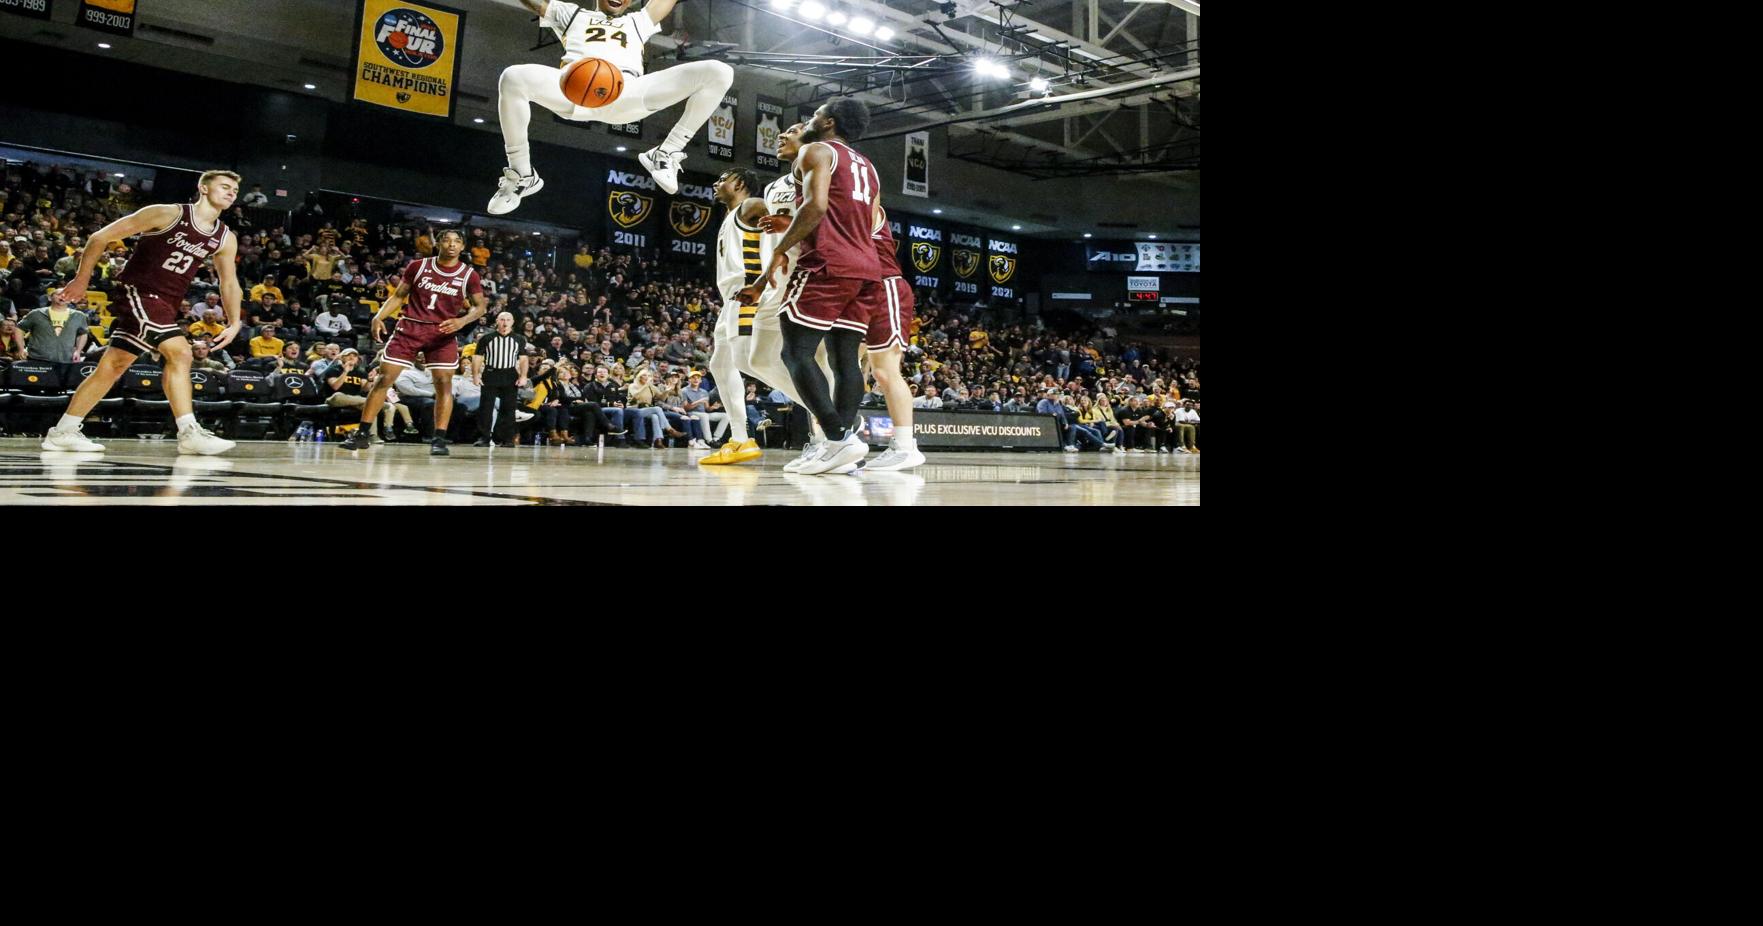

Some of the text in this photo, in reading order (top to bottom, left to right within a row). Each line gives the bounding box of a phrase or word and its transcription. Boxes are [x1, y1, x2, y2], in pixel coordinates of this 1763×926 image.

[86, 9, 131, 29] 999-2003
[395, 19, 436, 40] FINAL
[585, 27, 628, 48] 24
[376, 24, 436, 54] FOUR
[363, 61, 446, 85] SOUTHWEST REGIONAL
[362, 69, 446, 96] CHAMPIONS
[710, 115, 733, 131] VCU
[714, 128, 727, 138] 21
[762, 136, 775, 149] 22
[907, 158, 926, 169] VCU
[607, 169, 656, 191] NCAA
[850, 161, 871, 206] 11
[771, 191, 796, 204] VCU
[614, 231, 645, 248] 2011
[909, 225, 942, 241] NCAA
[951, 233, 981, 248] NCAA
[166, 231, 210, 259] Fordham
[672, 239, 706, 255] 2012
[988, 239, 1018, 254] NCAA
[161, 250, 194, 275] 23
[418, 276, 459, 296] Fordham
[915, 275, 939, 288] 2017
[955, 281, 977, 294] 2019
[991, 286, 1013, 298] 2021
[427, 293, 438, 310] 1
[914, 423, 1041, 437] PLUS EXCLUSIVE VCU DISCOUNTS
